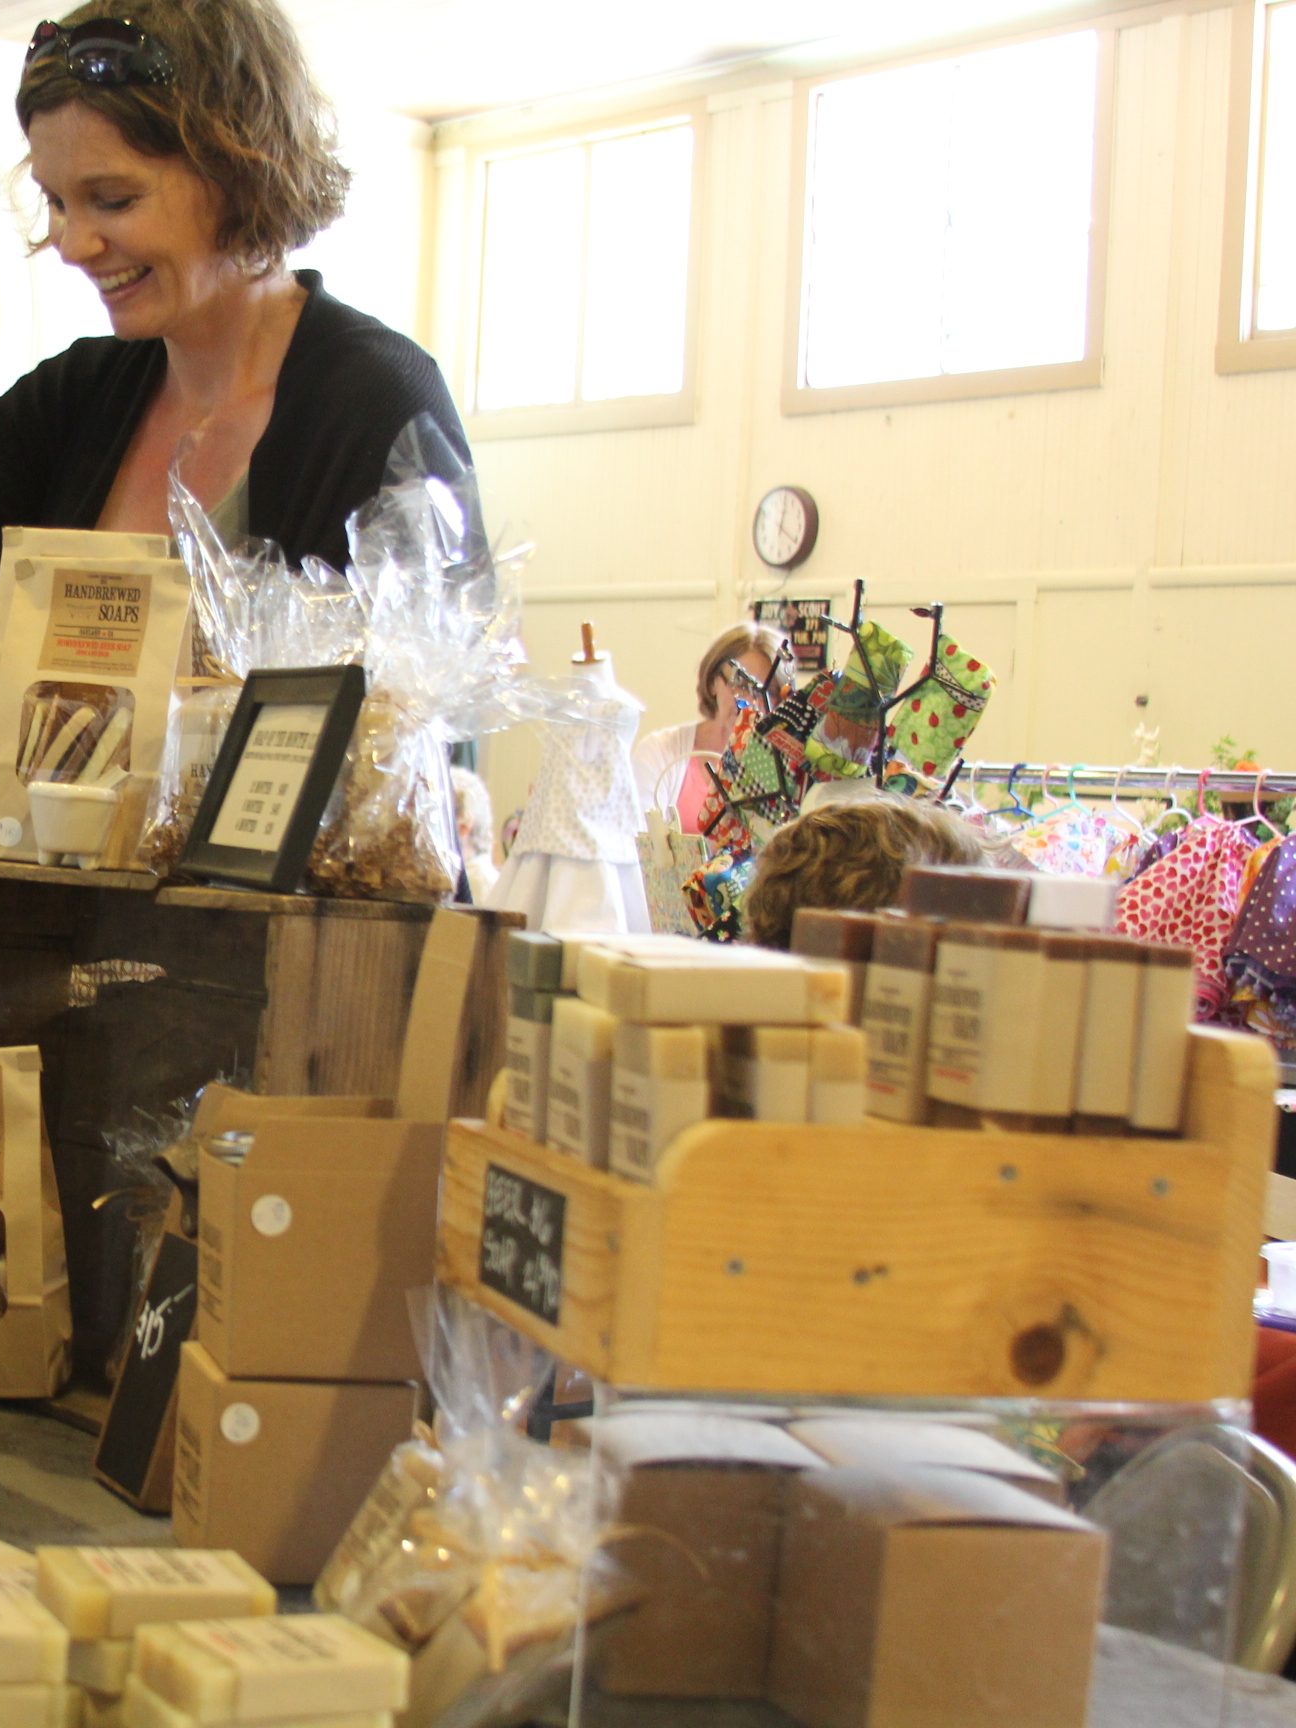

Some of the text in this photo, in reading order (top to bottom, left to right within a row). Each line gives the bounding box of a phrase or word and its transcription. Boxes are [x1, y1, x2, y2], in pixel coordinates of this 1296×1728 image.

[65, 584, 141, 603] HANDBREWED
[98, 604, 140, 624] SOAPS
[798, 602, 826, 618] SCOUT
